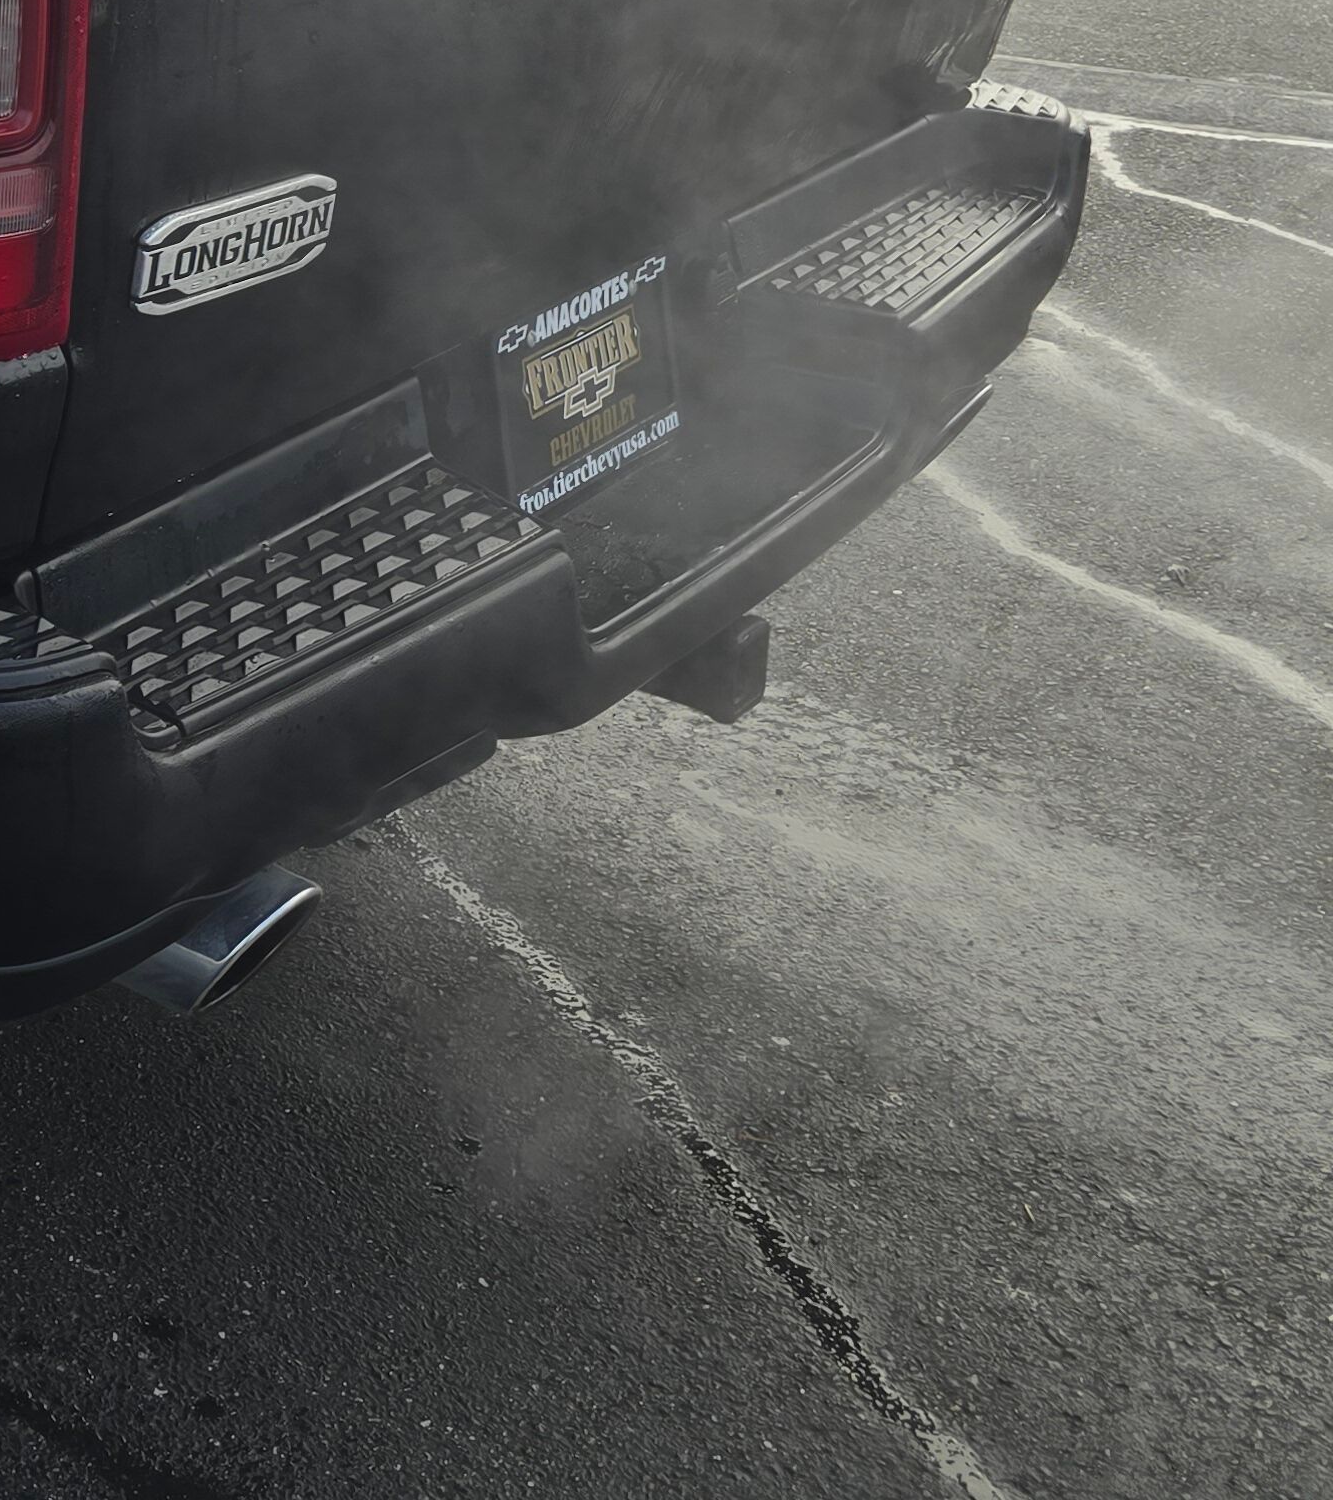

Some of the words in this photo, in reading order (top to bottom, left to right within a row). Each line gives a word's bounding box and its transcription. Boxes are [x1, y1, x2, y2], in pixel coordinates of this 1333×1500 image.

[144, 201, 333, 295] LONGHORN
[533, 271, 629, 343] ANACORTES
[526, 313, 638, 411] FRONTIER
[549, 393, 636, 467] CHEVROLET
